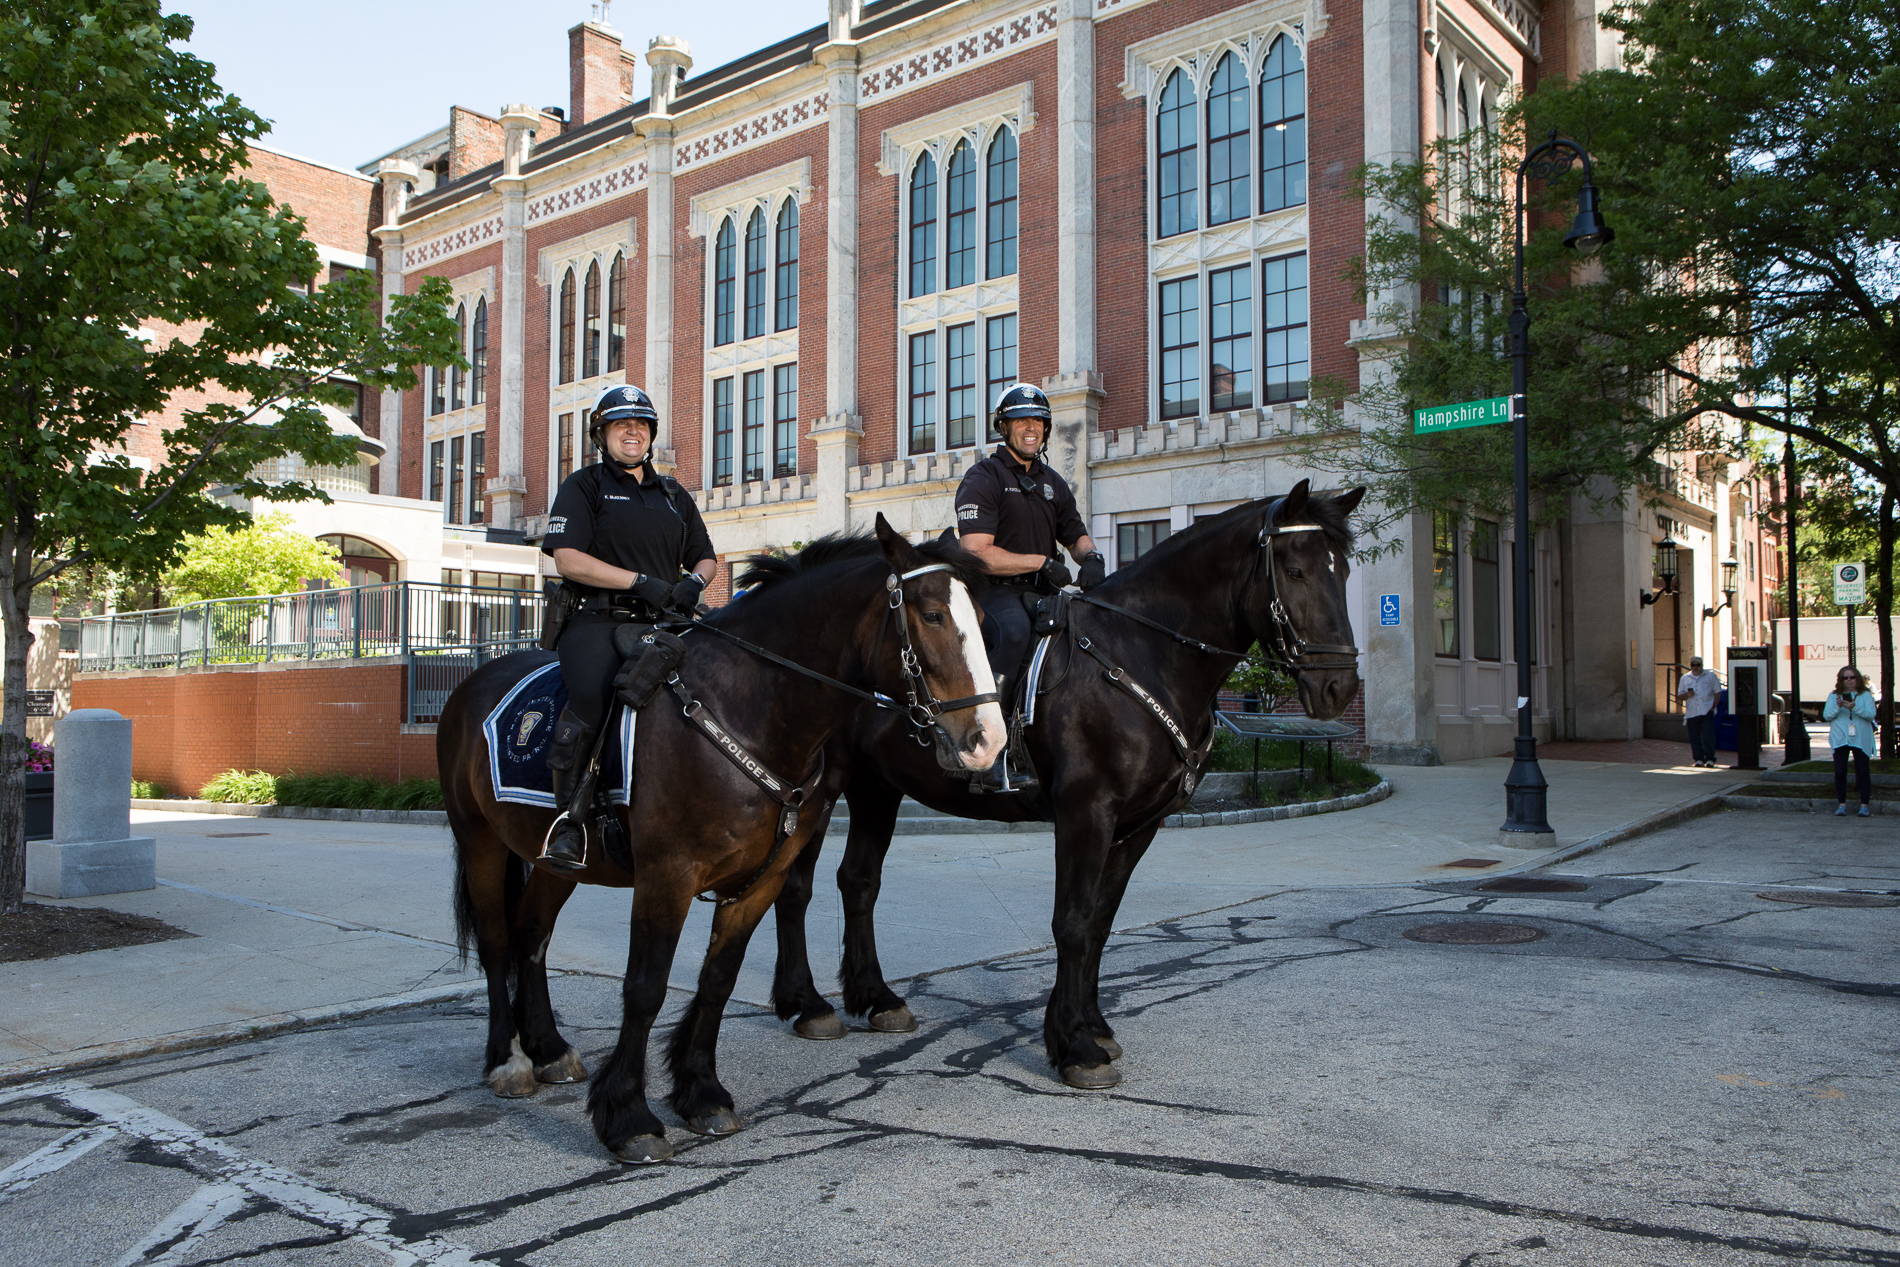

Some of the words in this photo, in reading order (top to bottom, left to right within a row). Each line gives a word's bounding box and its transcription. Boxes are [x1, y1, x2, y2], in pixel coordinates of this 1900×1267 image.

[1419, 404, 1485, 427] Hampshire
[1492, 401, 1507, 417] Ln
[957, 509, 979, 521] POLICE
[1147, 697, 1179, 734] POLICE
[720, 735, 764, 778] POLICE
